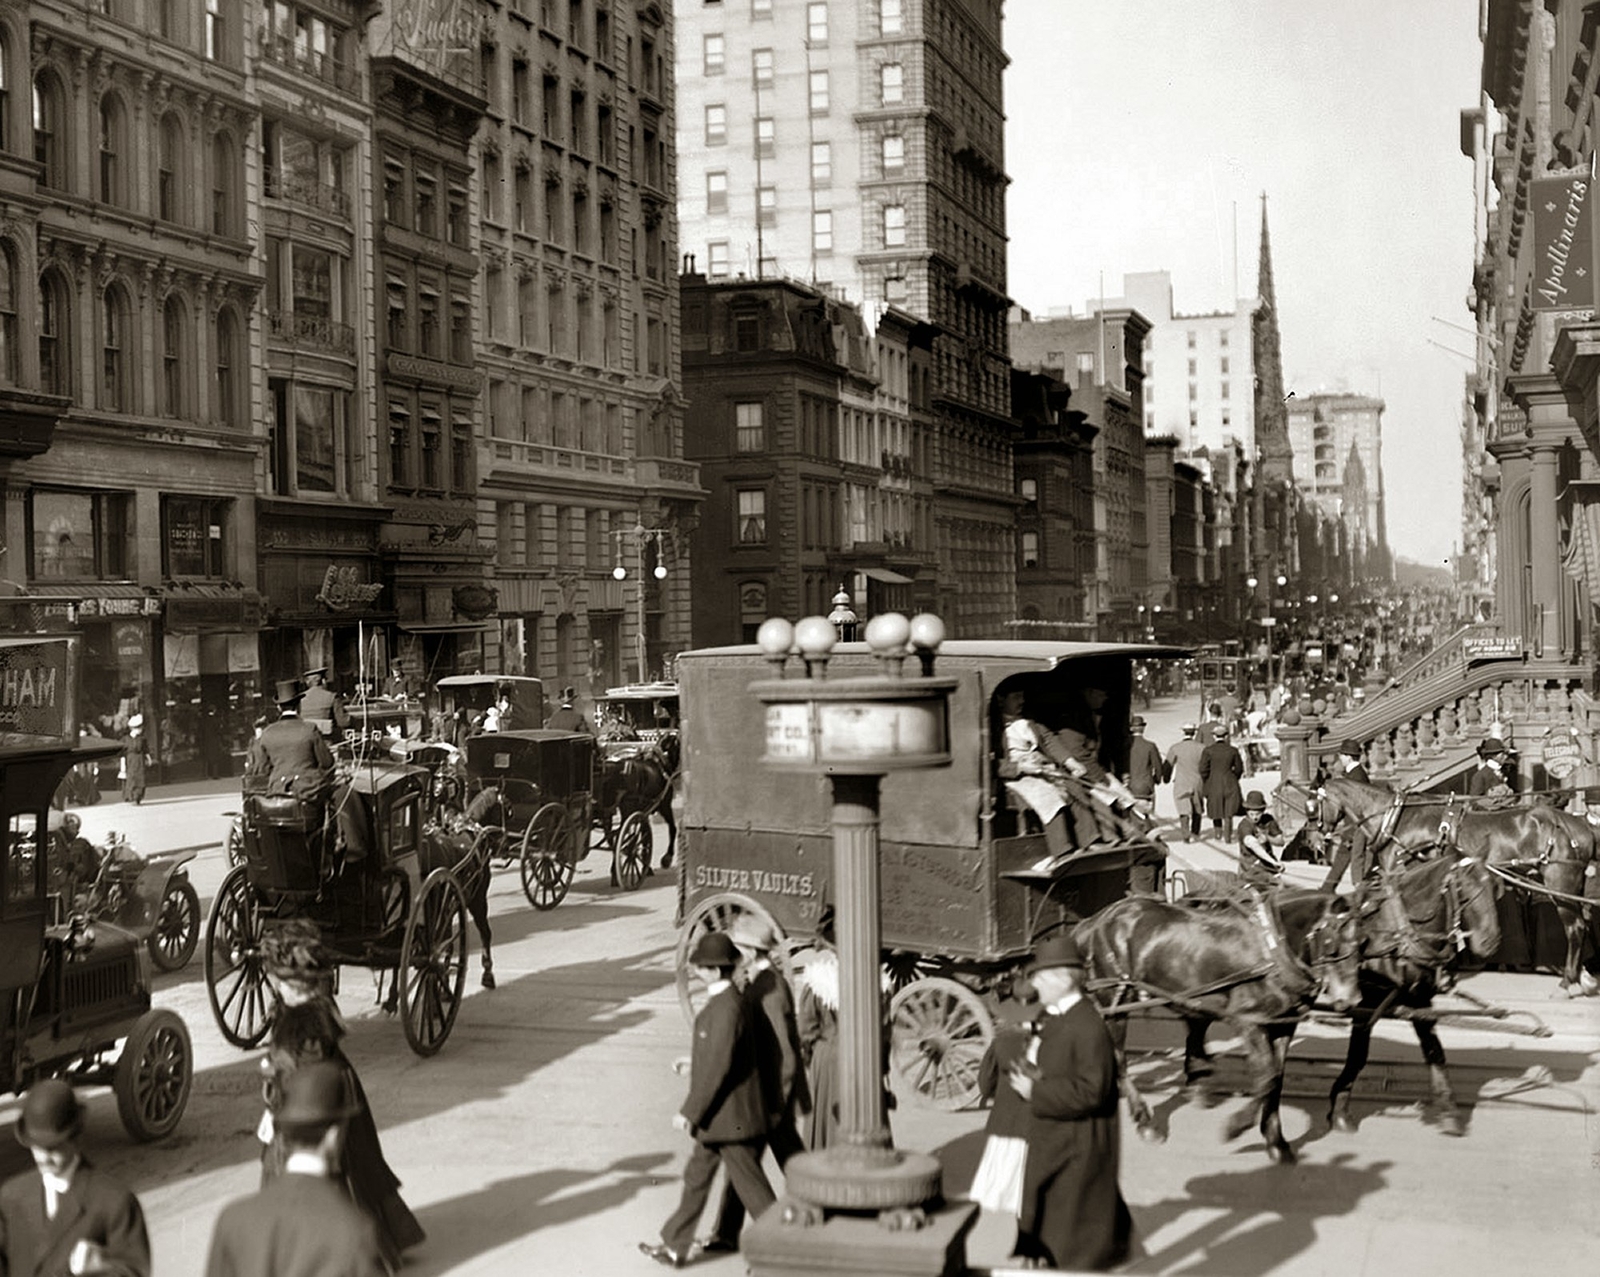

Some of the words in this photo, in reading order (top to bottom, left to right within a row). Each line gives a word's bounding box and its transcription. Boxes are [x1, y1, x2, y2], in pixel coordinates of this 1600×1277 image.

[1538, 180, 1588, 305] Apollinaris
[1464, 637, 1494, 647] OFFICES
[0, 667, 56, 707] HAM
[696, 865, 750, 890] SILVER
